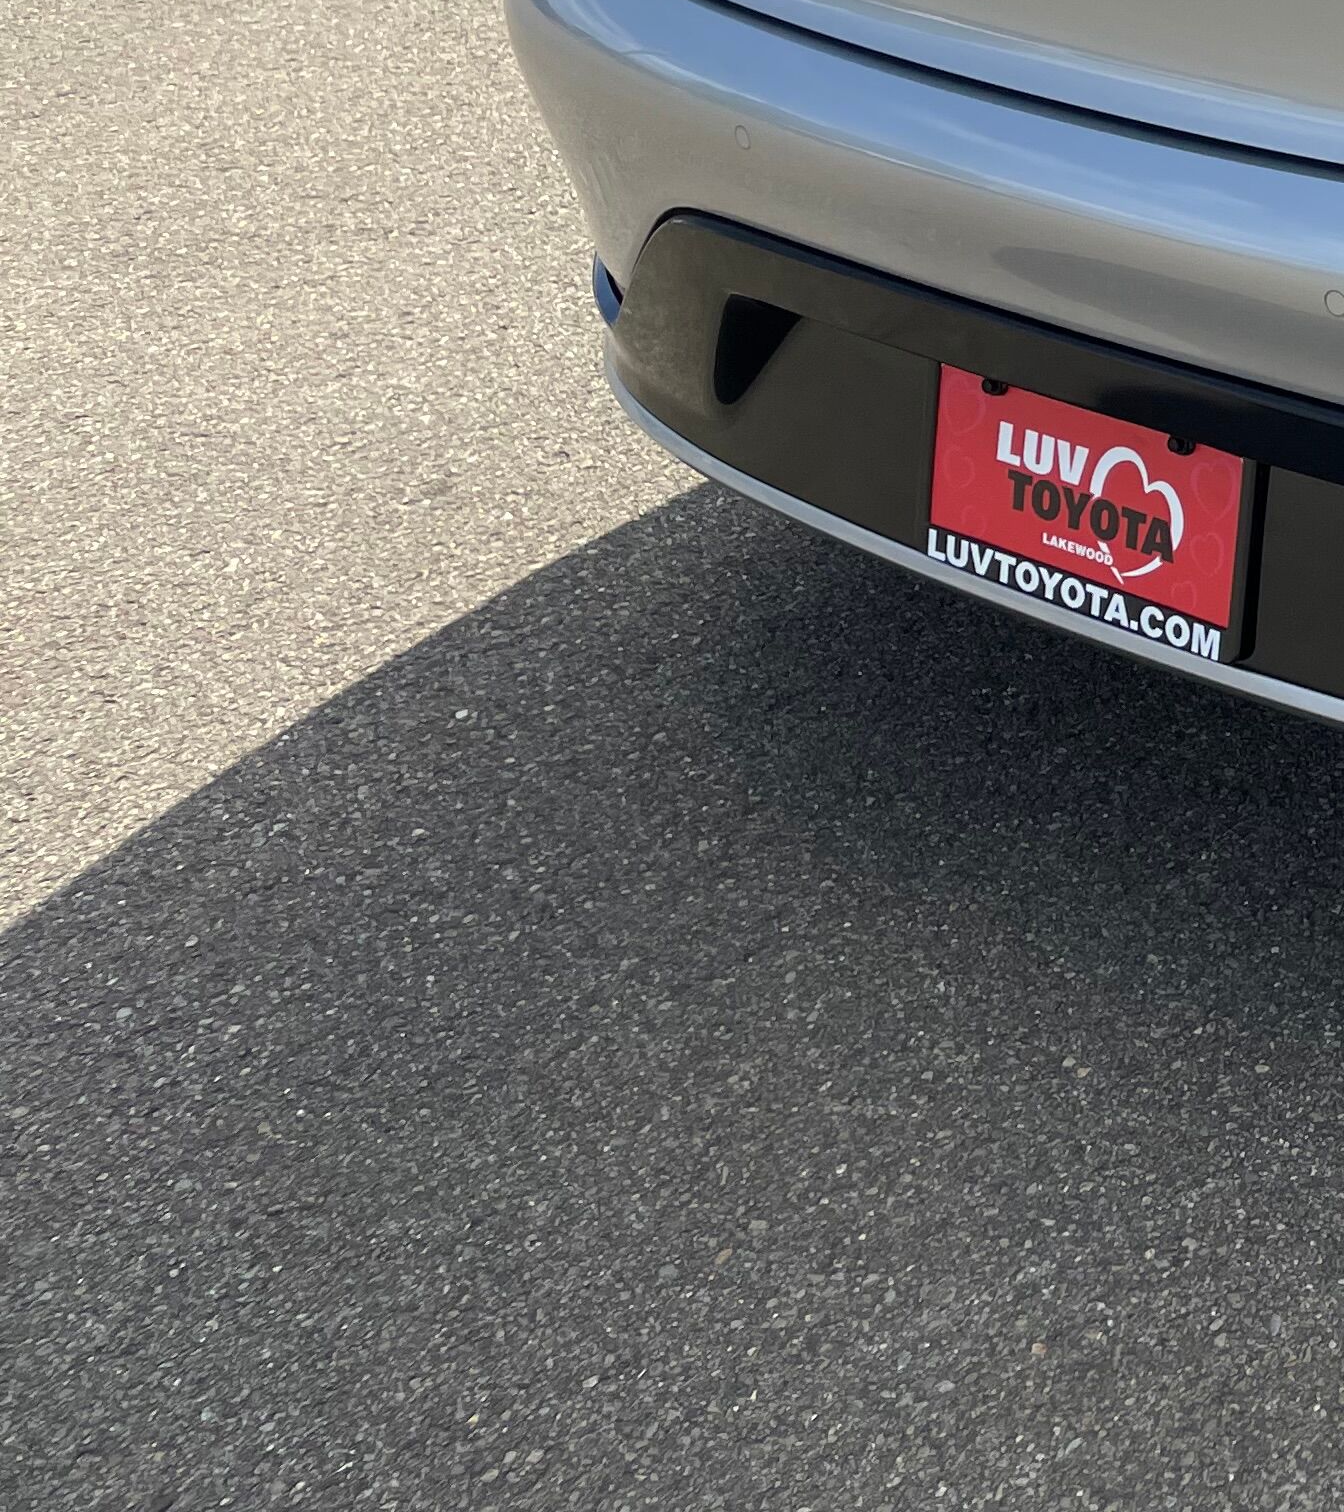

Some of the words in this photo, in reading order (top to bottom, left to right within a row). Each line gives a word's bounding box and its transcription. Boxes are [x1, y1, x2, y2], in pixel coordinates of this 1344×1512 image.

[996, 421, 1089, 485] LUV
[1007, 470, 1175, 563] TOYOTA
[1042, 532, 1114, 567] LAKEWOOD
[927, 528, 1222, 662] LUVTOYOTA.COM
